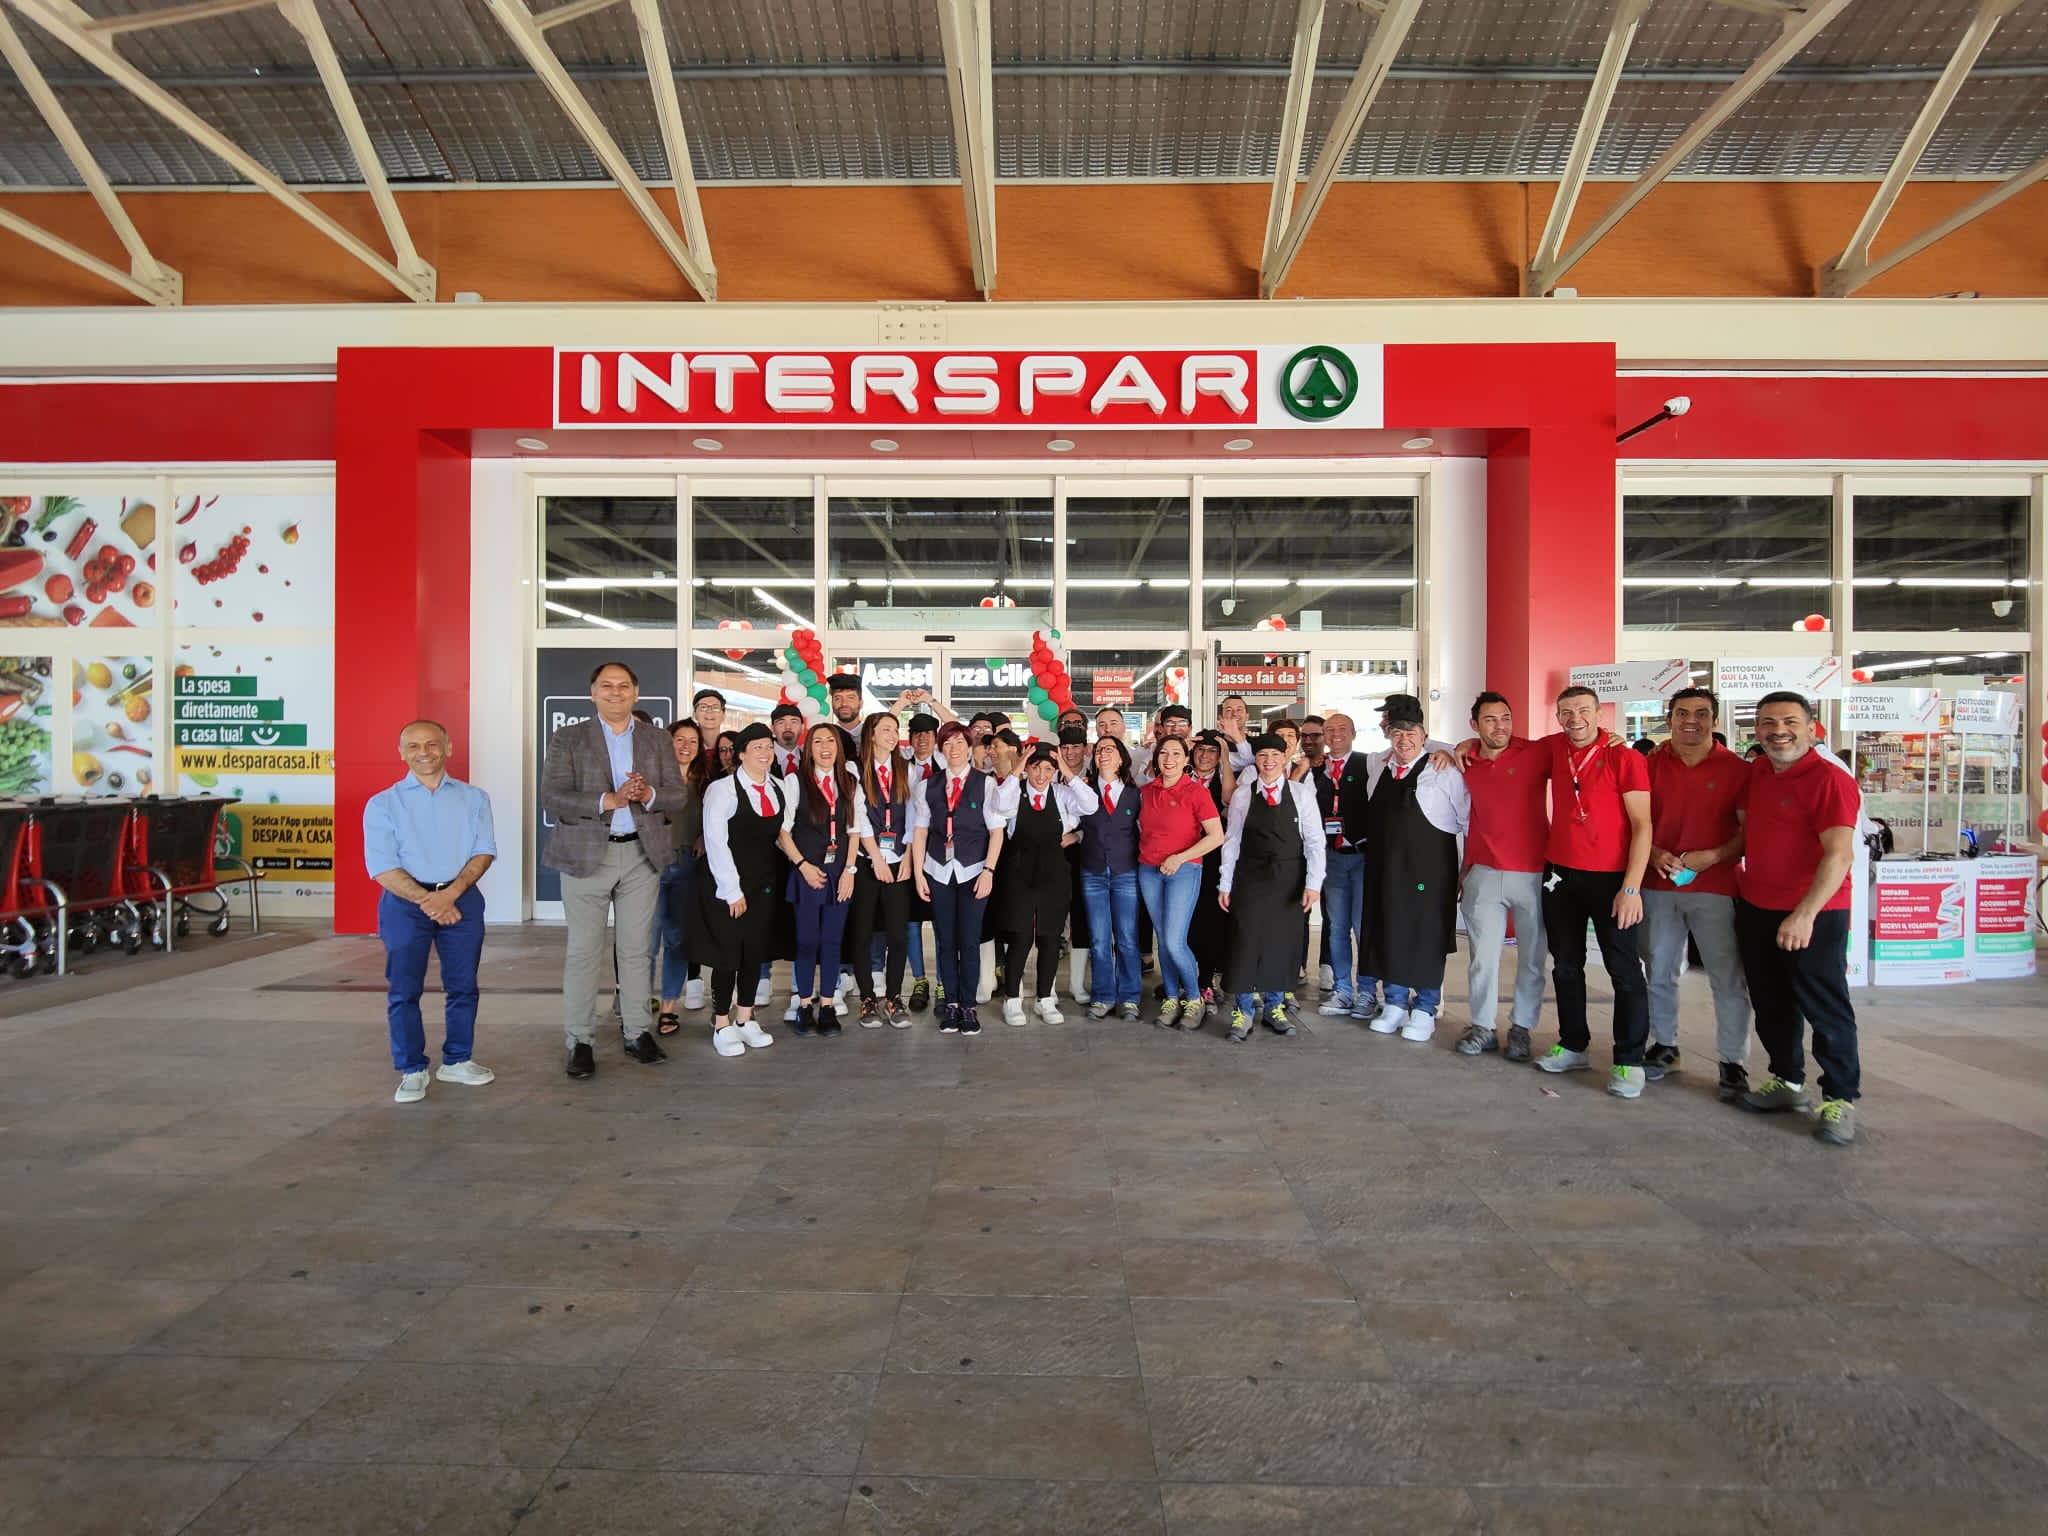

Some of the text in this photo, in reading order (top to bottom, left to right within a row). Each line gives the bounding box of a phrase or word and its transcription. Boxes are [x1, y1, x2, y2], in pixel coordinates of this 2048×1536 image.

[580, 352, 1250, 416] INTERSPAR
[864, 663, 989, 686] Assistnza
[1256, 671, 1274, 684] fai
[1278, 671, 1296, 684] da
[1572, 671, 1620, 680] SOTTOSCRIVI
[1720, 665, 1774, 673] SOTTOSCRIVI
[182, 676, 231, 696] La spesa
[181, 702, 259, 719] direttamente
[180, 726, 244, 743] a casa tua!
[181, 751, 320, 772] www.desparacasa.it
[252, 815, 333, 828] Scarica l'App gratuita
[252, 828, 333, 844] DESPAR A CASA
